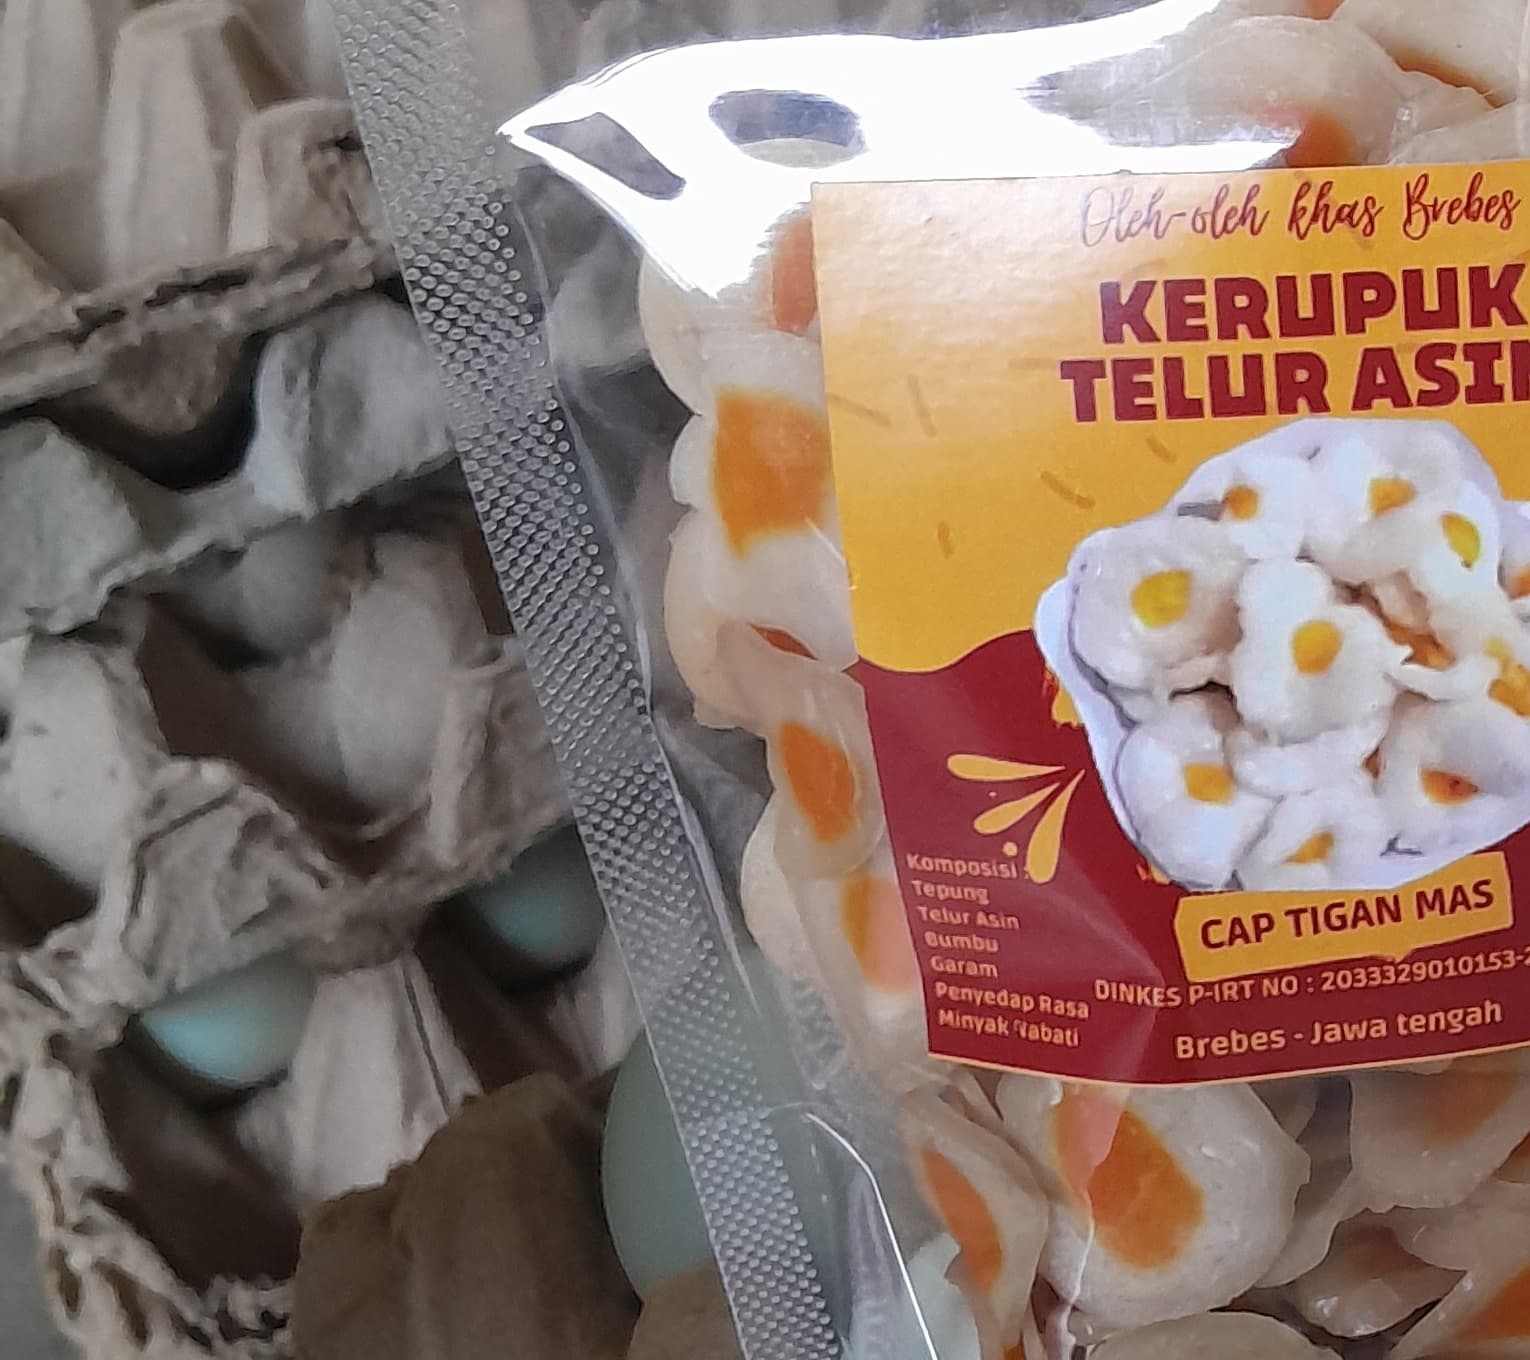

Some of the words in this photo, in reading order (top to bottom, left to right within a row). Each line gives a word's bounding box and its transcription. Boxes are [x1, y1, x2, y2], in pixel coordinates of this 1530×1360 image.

[1080, 183, 1271, 247] Oleh-oleh
[1288, 179, 1384, 241] khas
[1402, 172, 1521, 241] Brebes
[1100, 263, 1529, 344] KERUPUK
[1060, 351, 1331, 423] TELUR
[906, 853, 1018, 880] Komposisi
[911, 879, 990, 905] Tepung
[917, 905, 971, 925] Telur
[975, 911, 1020, 930] Asin
[1201, 913, 1275, 949] CAP
[1284, 893, 1402, 938] TIGAN
[1415, 878, 1494, 920] MAS
[924, 931, 999, 953] Bumbu
[930, 955, 999, 979] Garam
[935, 981, 1035, 1013] Penyedap
[1039, 994, 1090, 1020] Rasa
[1094, 979, 1183, 1008] DINKES
[1189, 980, 1255, 1006] P-IRT
[1262, 975, 1298, 998] NO
[938, 1009, 1009, 1036] Minyak
[1176, 1027, 1286, 1059] Brebes
[1310, 1018, 1388, 1046] Jawa
[1396, 999, 1503, 1035] tengah
